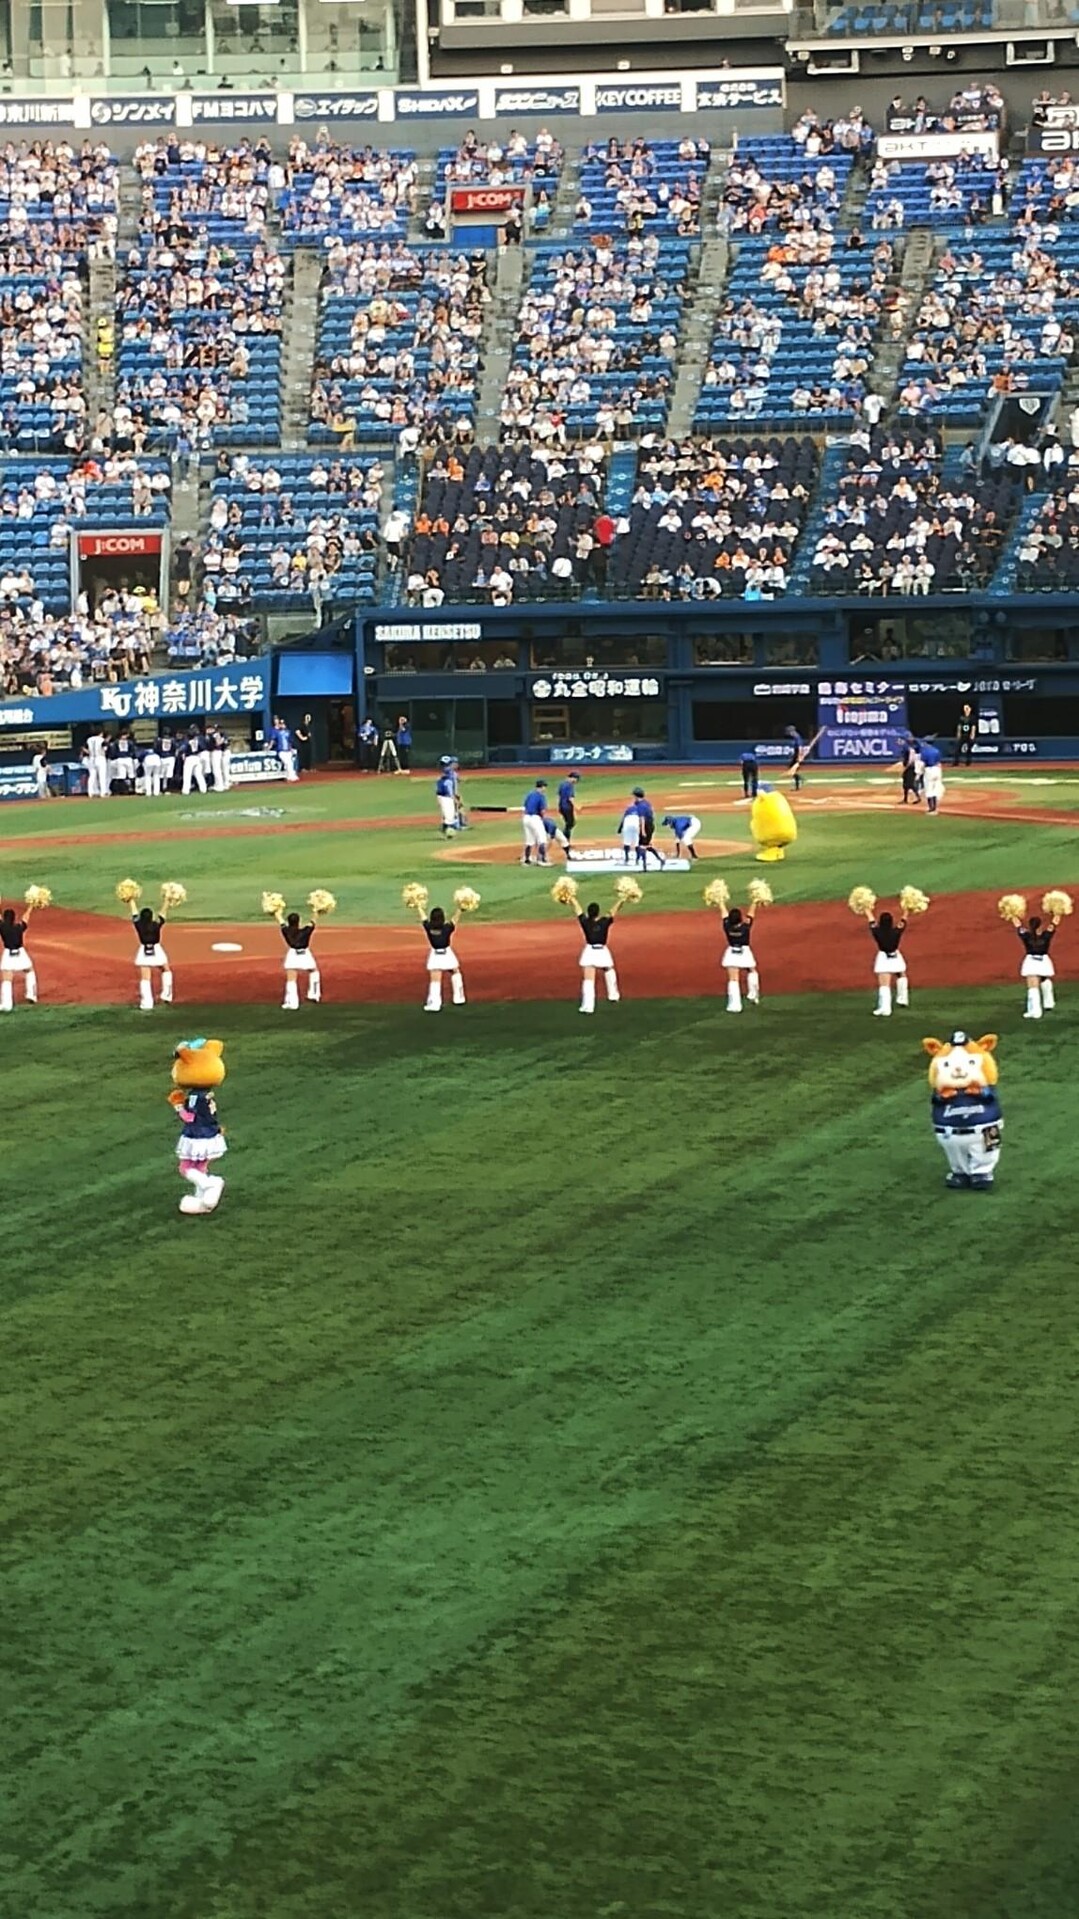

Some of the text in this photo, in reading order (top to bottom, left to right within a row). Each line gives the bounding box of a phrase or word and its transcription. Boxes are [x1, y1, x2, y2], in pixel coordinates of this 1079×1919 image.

[597, 90, 625, 107] KEY
[625, 89, 682, 106] COFFEE
[95, 538, 145, 554] J:COM
[135, 675, 264, 715] 神奈川大学
[833, 738, 893, 756] FANCL
